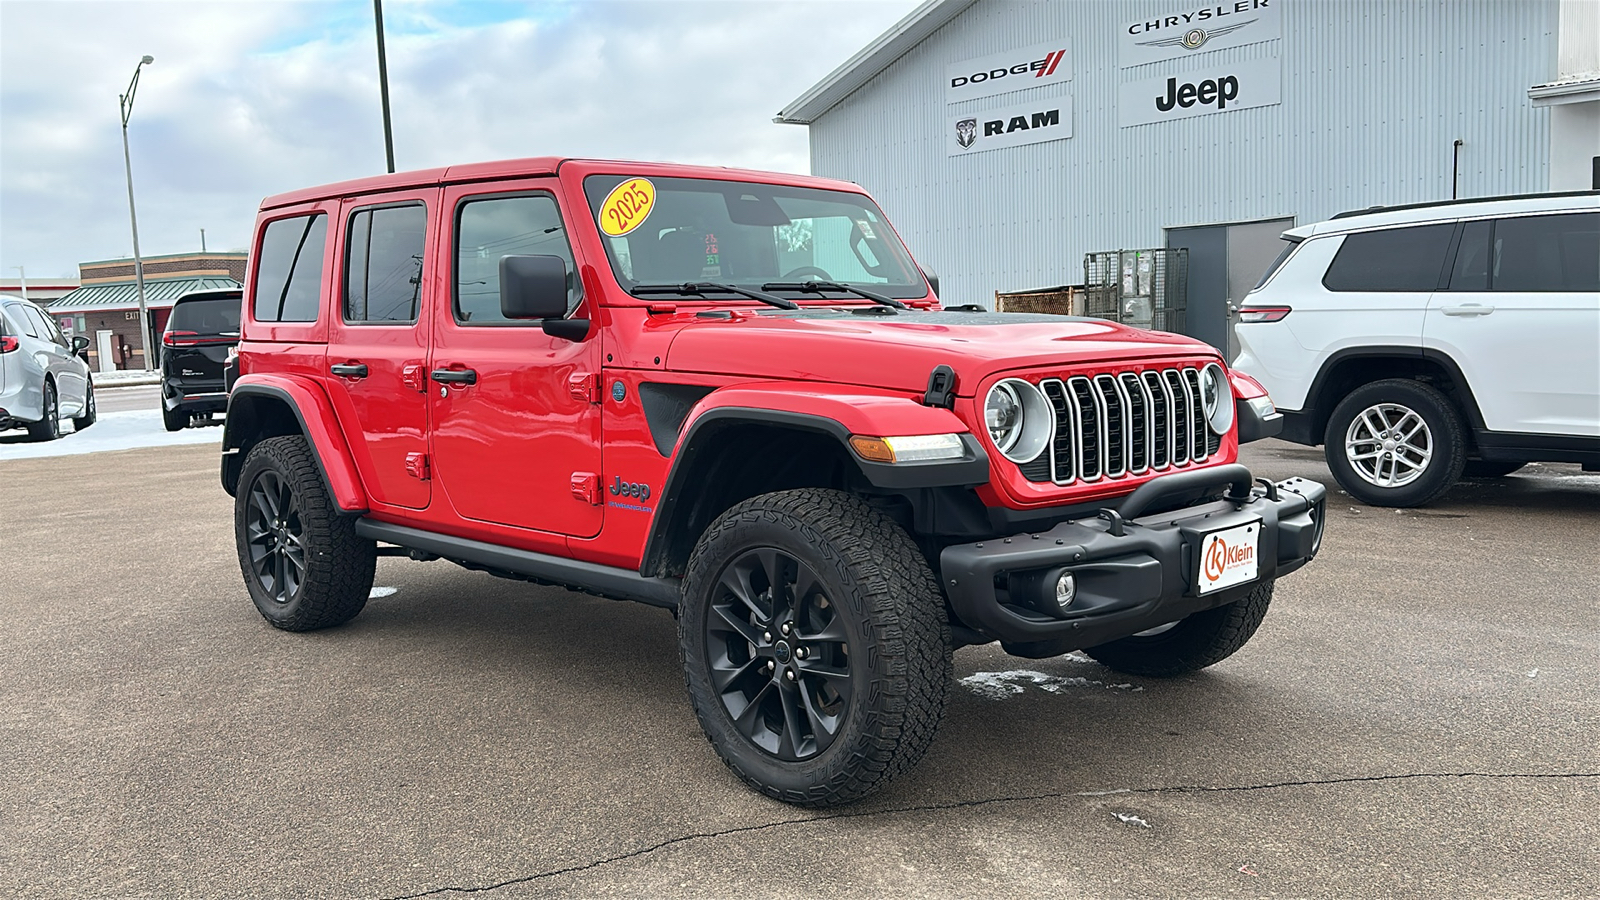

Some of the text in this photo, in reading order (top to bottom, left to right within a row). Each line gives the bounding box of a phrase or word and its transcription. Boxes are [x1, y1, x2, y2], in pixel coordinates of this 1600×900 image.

[1128, 0, 1269, 34] CHRYSLER
[951, 59, 1048, 88] DODGE
[1155, 75, 1239, 112] Jeep
[984, 109, 1060, 137] RAM
[608, 182, 649, 231] 2025
[125, 311, 140, 320] EXIT
[609, 475, 650, 502] Jeep
[1227, 542, 1253, 565] Klein
